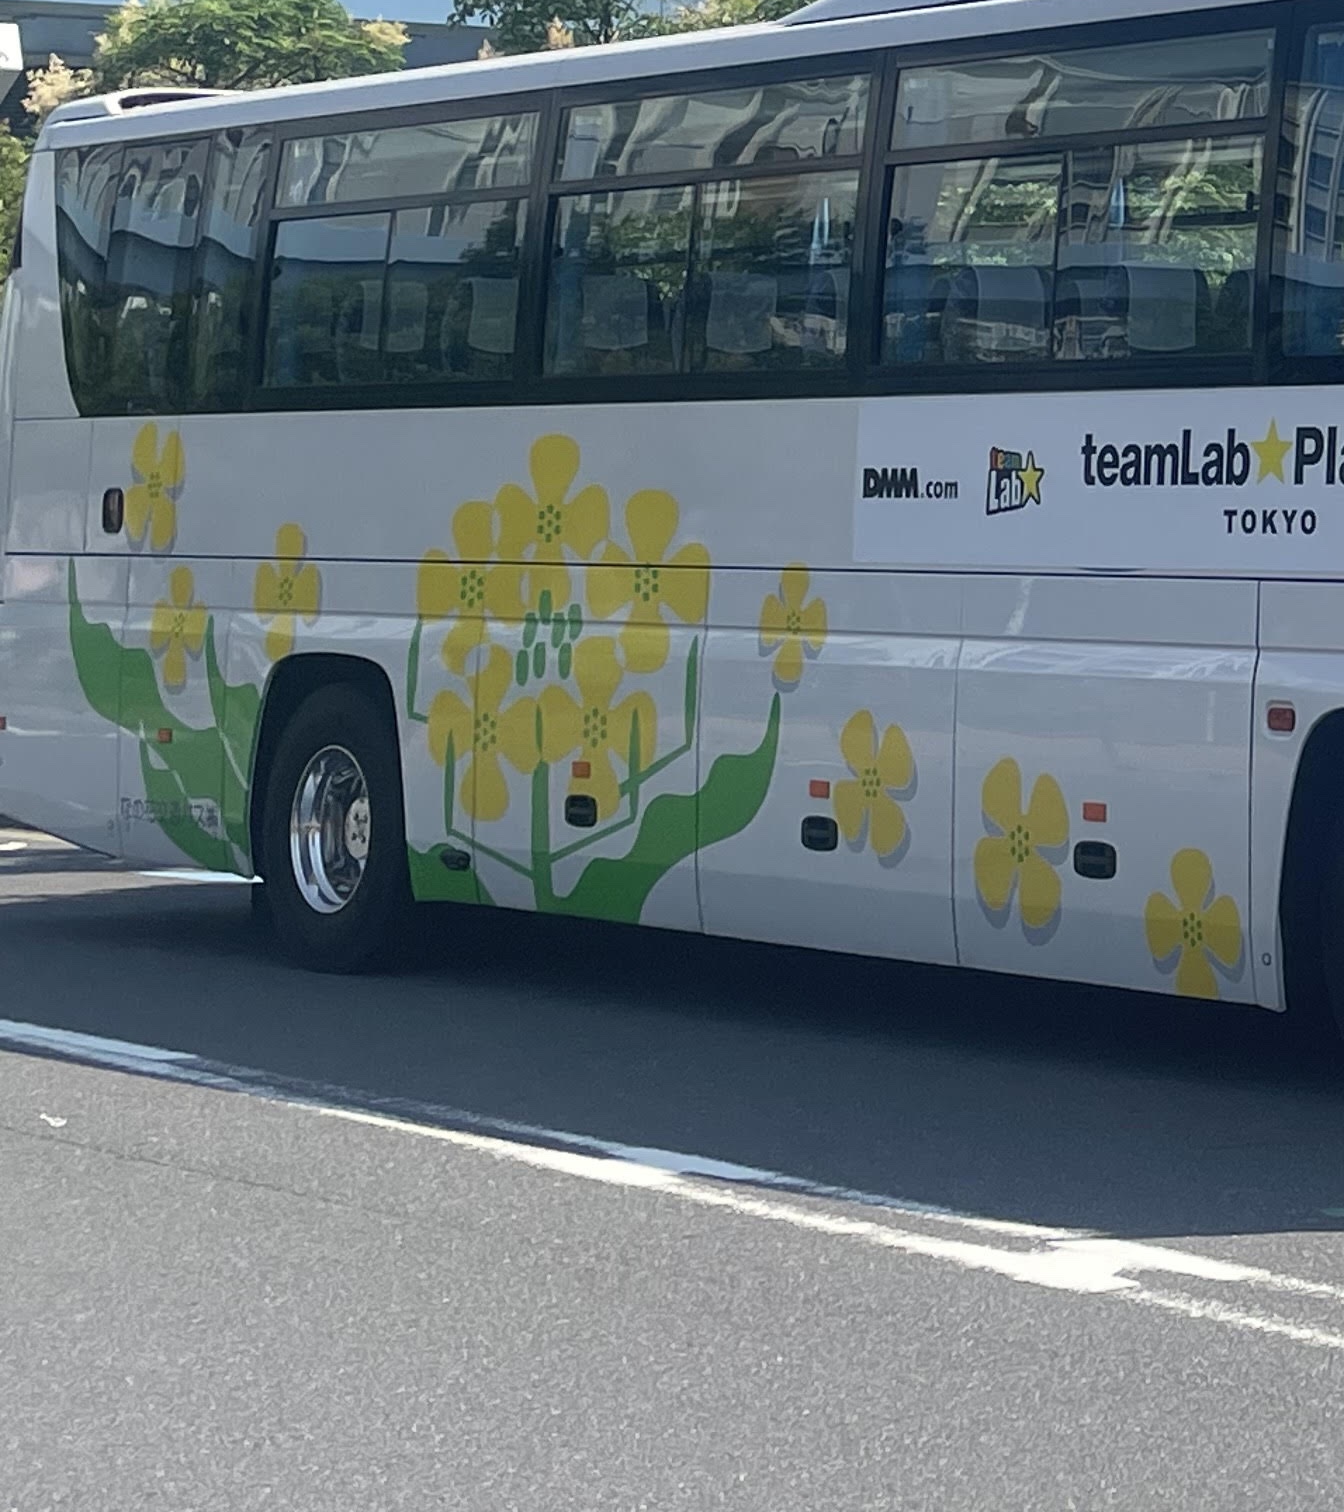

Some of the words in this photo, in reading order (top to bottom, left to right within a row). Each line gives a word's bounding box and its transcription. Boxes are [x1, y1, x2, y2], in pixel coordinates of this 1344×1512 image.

[1081, 428, 1250, 486] teamLab
[863, 467, 958, 499] DMM.com
[988, 469, 1023, 511] Lab
[1223, 509, 1317, 535] TOKYO
